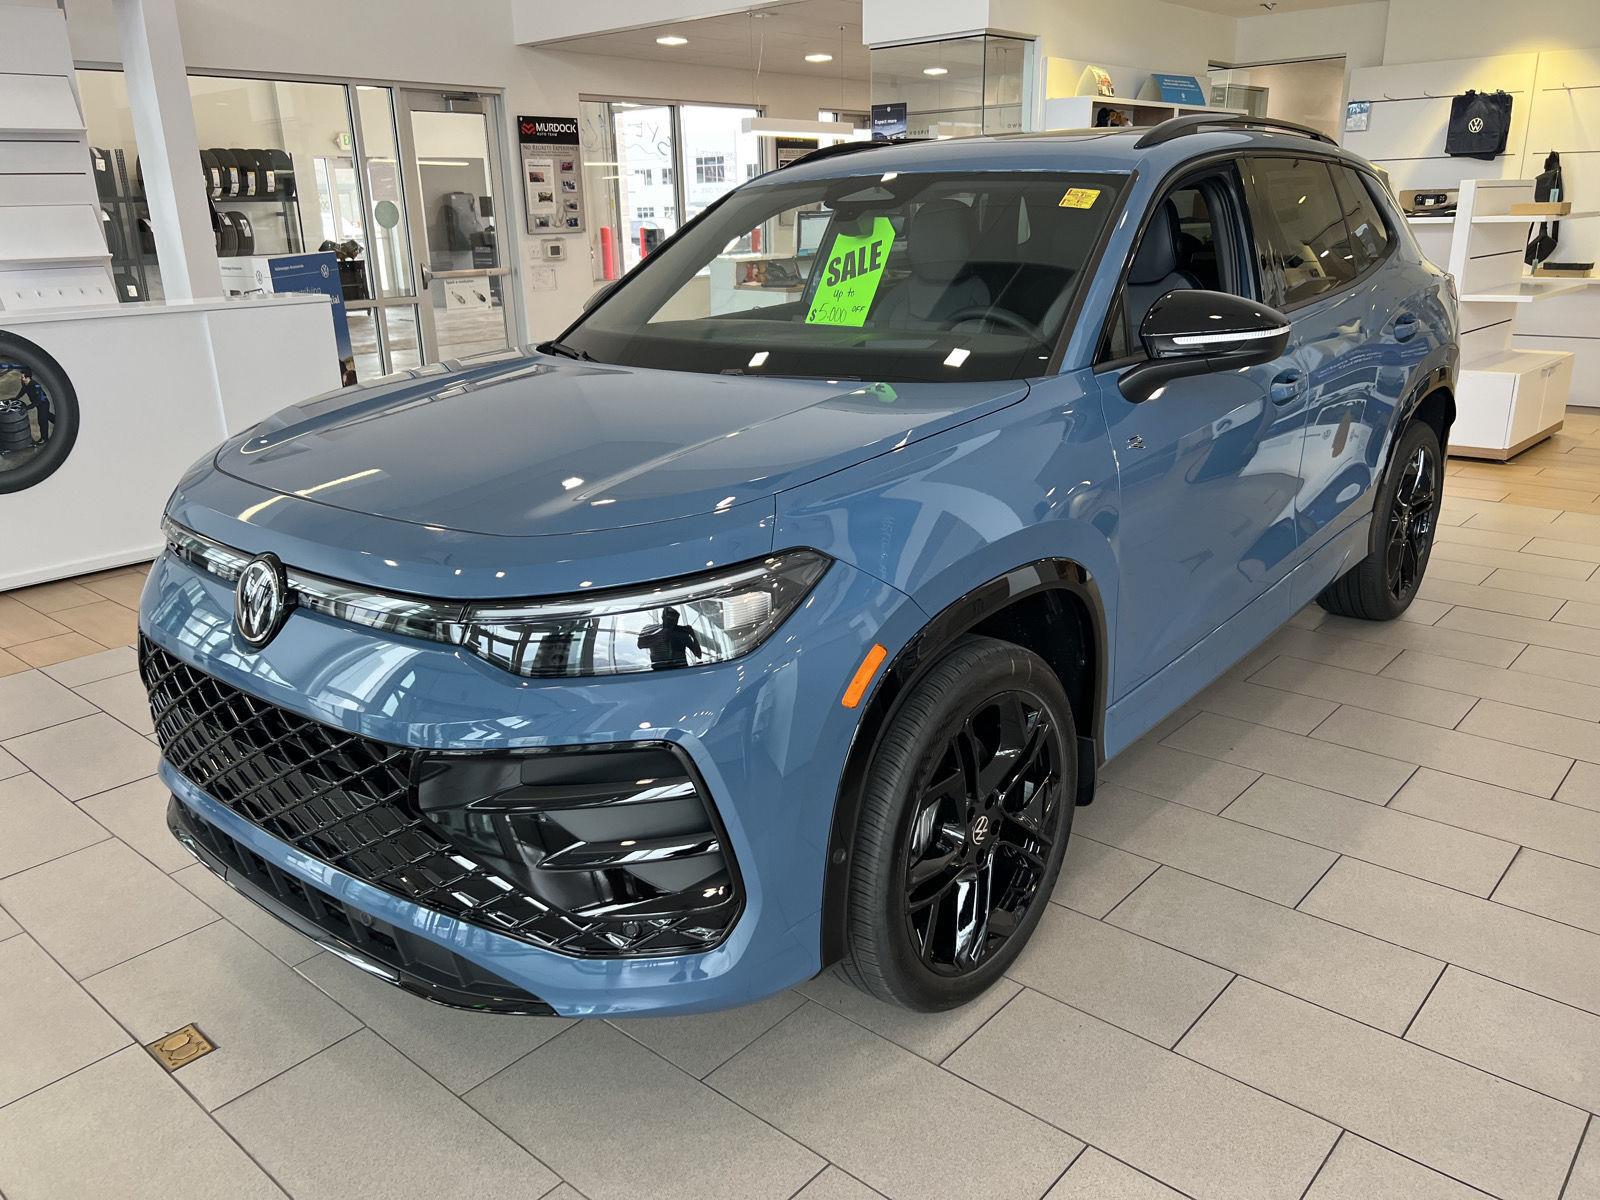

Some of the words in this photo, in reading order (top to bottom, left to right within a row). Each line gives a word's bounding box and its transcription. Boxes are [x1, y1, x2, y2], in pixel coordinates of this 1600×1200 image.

[535, 122, 577, 133] MURDOCK
[827, 240, 882, 287] SALE
[851, 305, 865, 313] OFF
